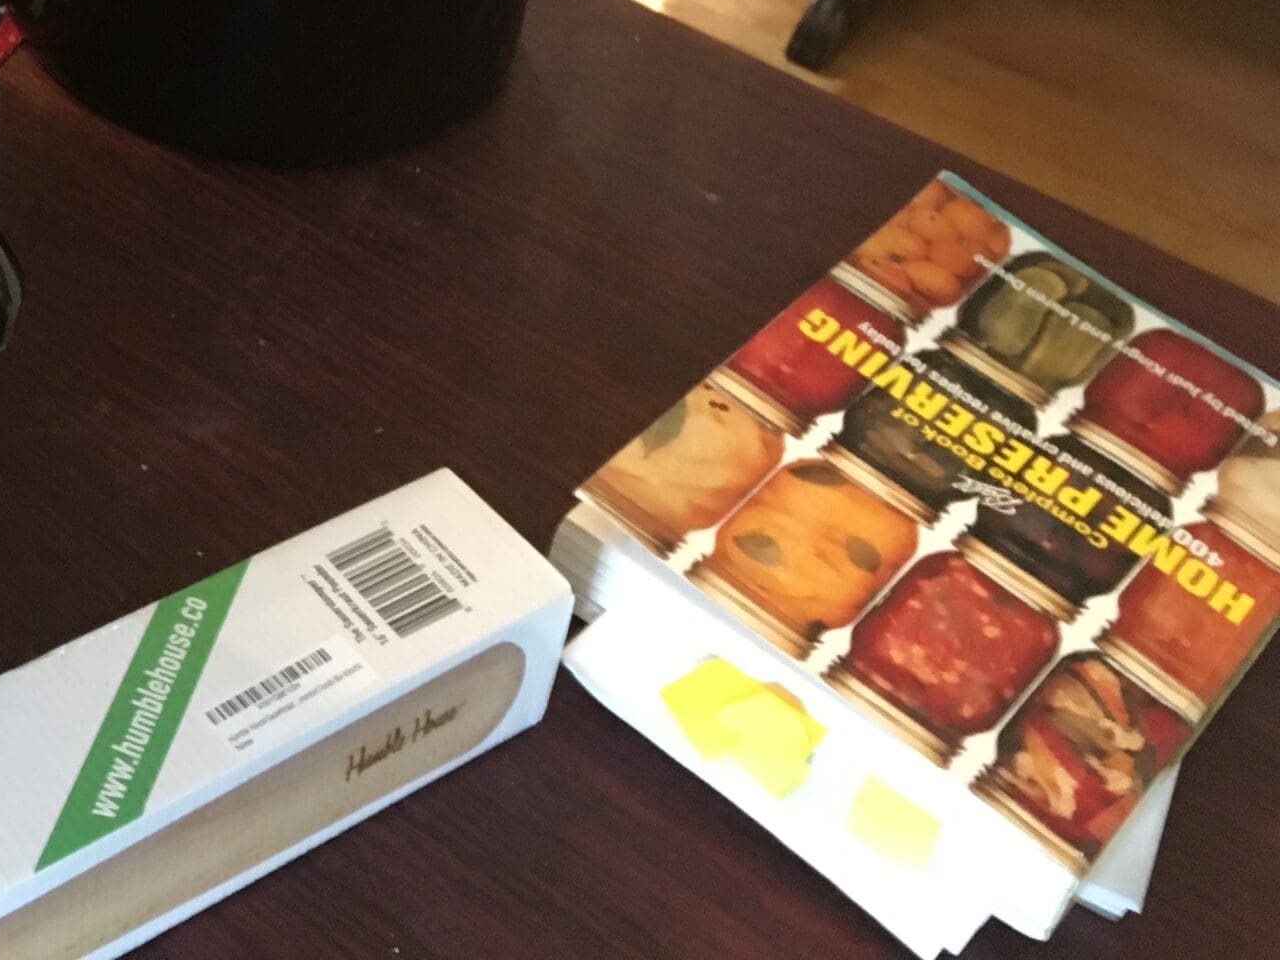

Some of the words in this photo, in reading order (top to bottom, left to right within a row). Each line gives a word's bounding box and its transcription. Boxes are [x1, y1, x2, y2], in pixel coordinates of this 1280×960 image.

[856, 319, 902, 356] today
[1079, 320, 1113, 345] and
[900, 351, 927, 373] for
[794, 305, 1103, 517] PRESERVING
[927, 368, 991, 414] recipes
[1201, 389, 1224, 409] by
[889, 406, 921, 427] of
[988, 409, 1061, 457] creative
[918, 423, 986, 470] Book
[1057, 450, 1094, 478] and
[951, 473, 1024, 515] Ball
[985, 463, 1111, 550] Complete
[1092, 472, 1174, 531] delicious
[410, 528, 437, 554] CHINA
[1171, 526, 1227, 568] 400
[444, 562, 469, 587] MADE
[1098, 503, 1257, 625] HOME
[91, 596, 207, 818] www.humblehouse.co
